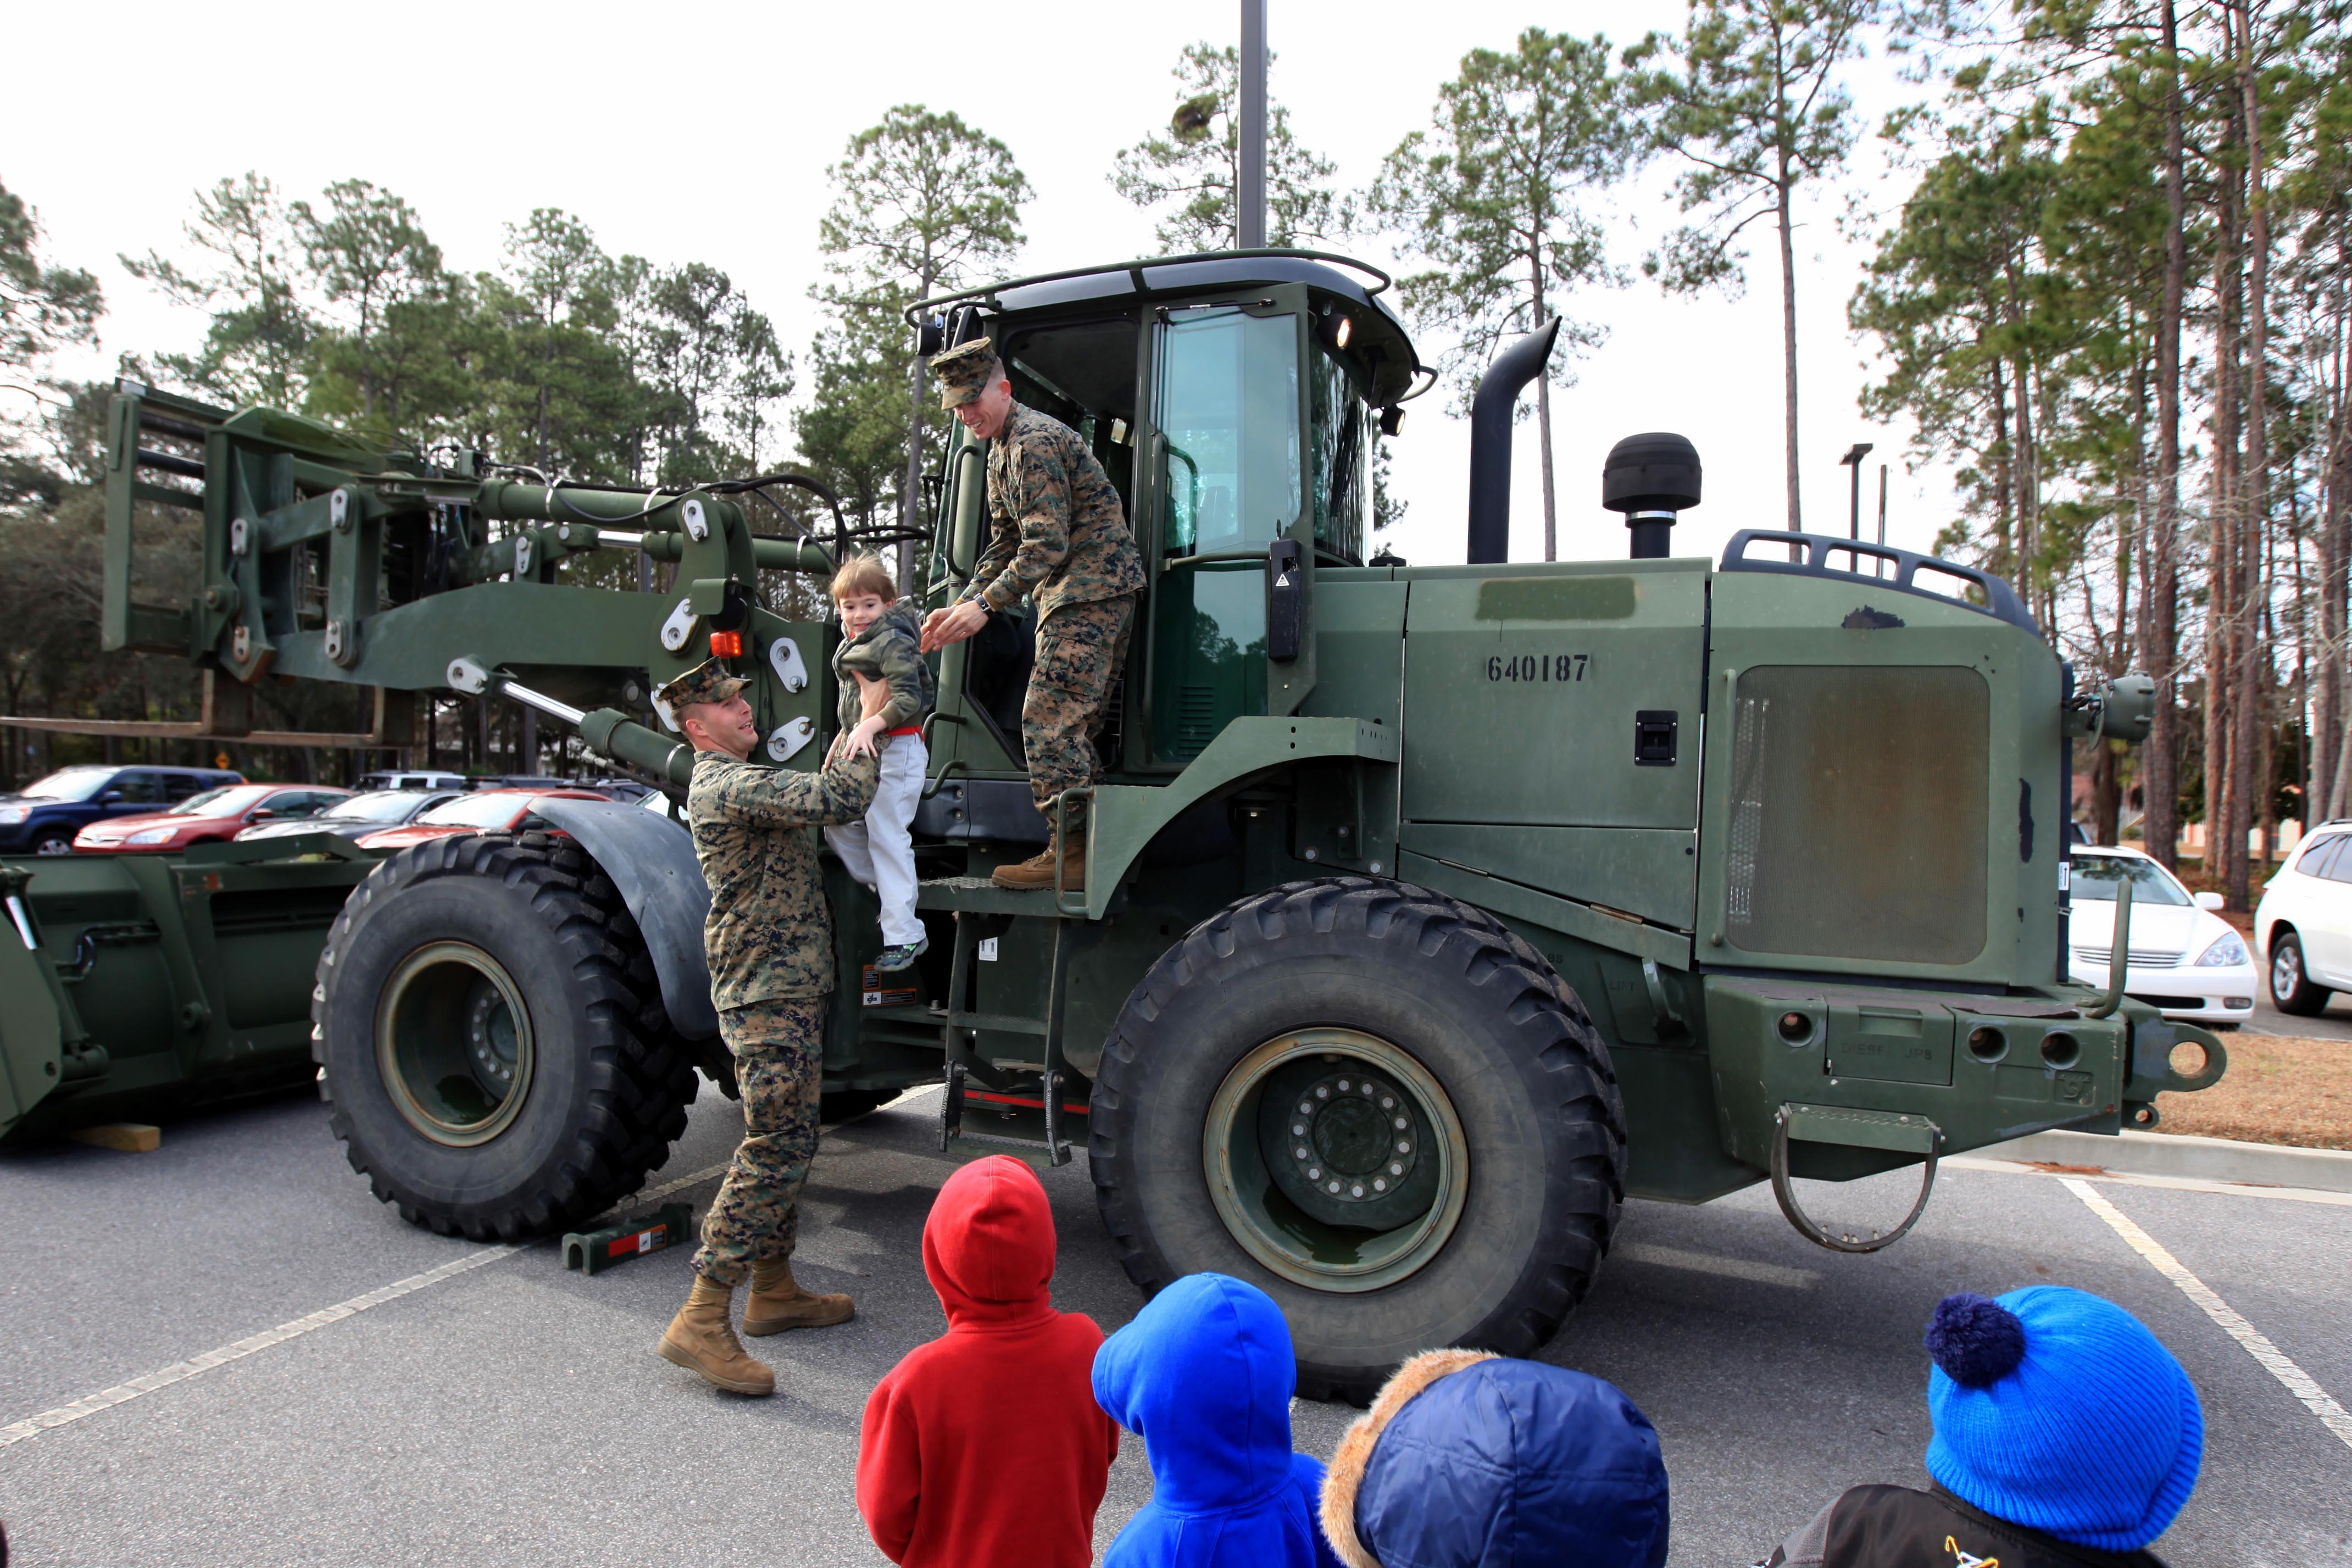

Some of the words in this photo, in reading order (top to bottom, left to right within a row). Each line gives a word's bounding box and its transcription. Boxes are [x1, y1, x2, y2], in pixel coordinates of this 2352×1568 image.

[1488, 654, 1588, 682] 640187
[1547, 953, 1564, 964] BS
[1610, 980, 1636, 991] LIFT
[1841, 1042, 1897, 1057] DIESEL
[1904, 1047, 1933, 1060] JP8
